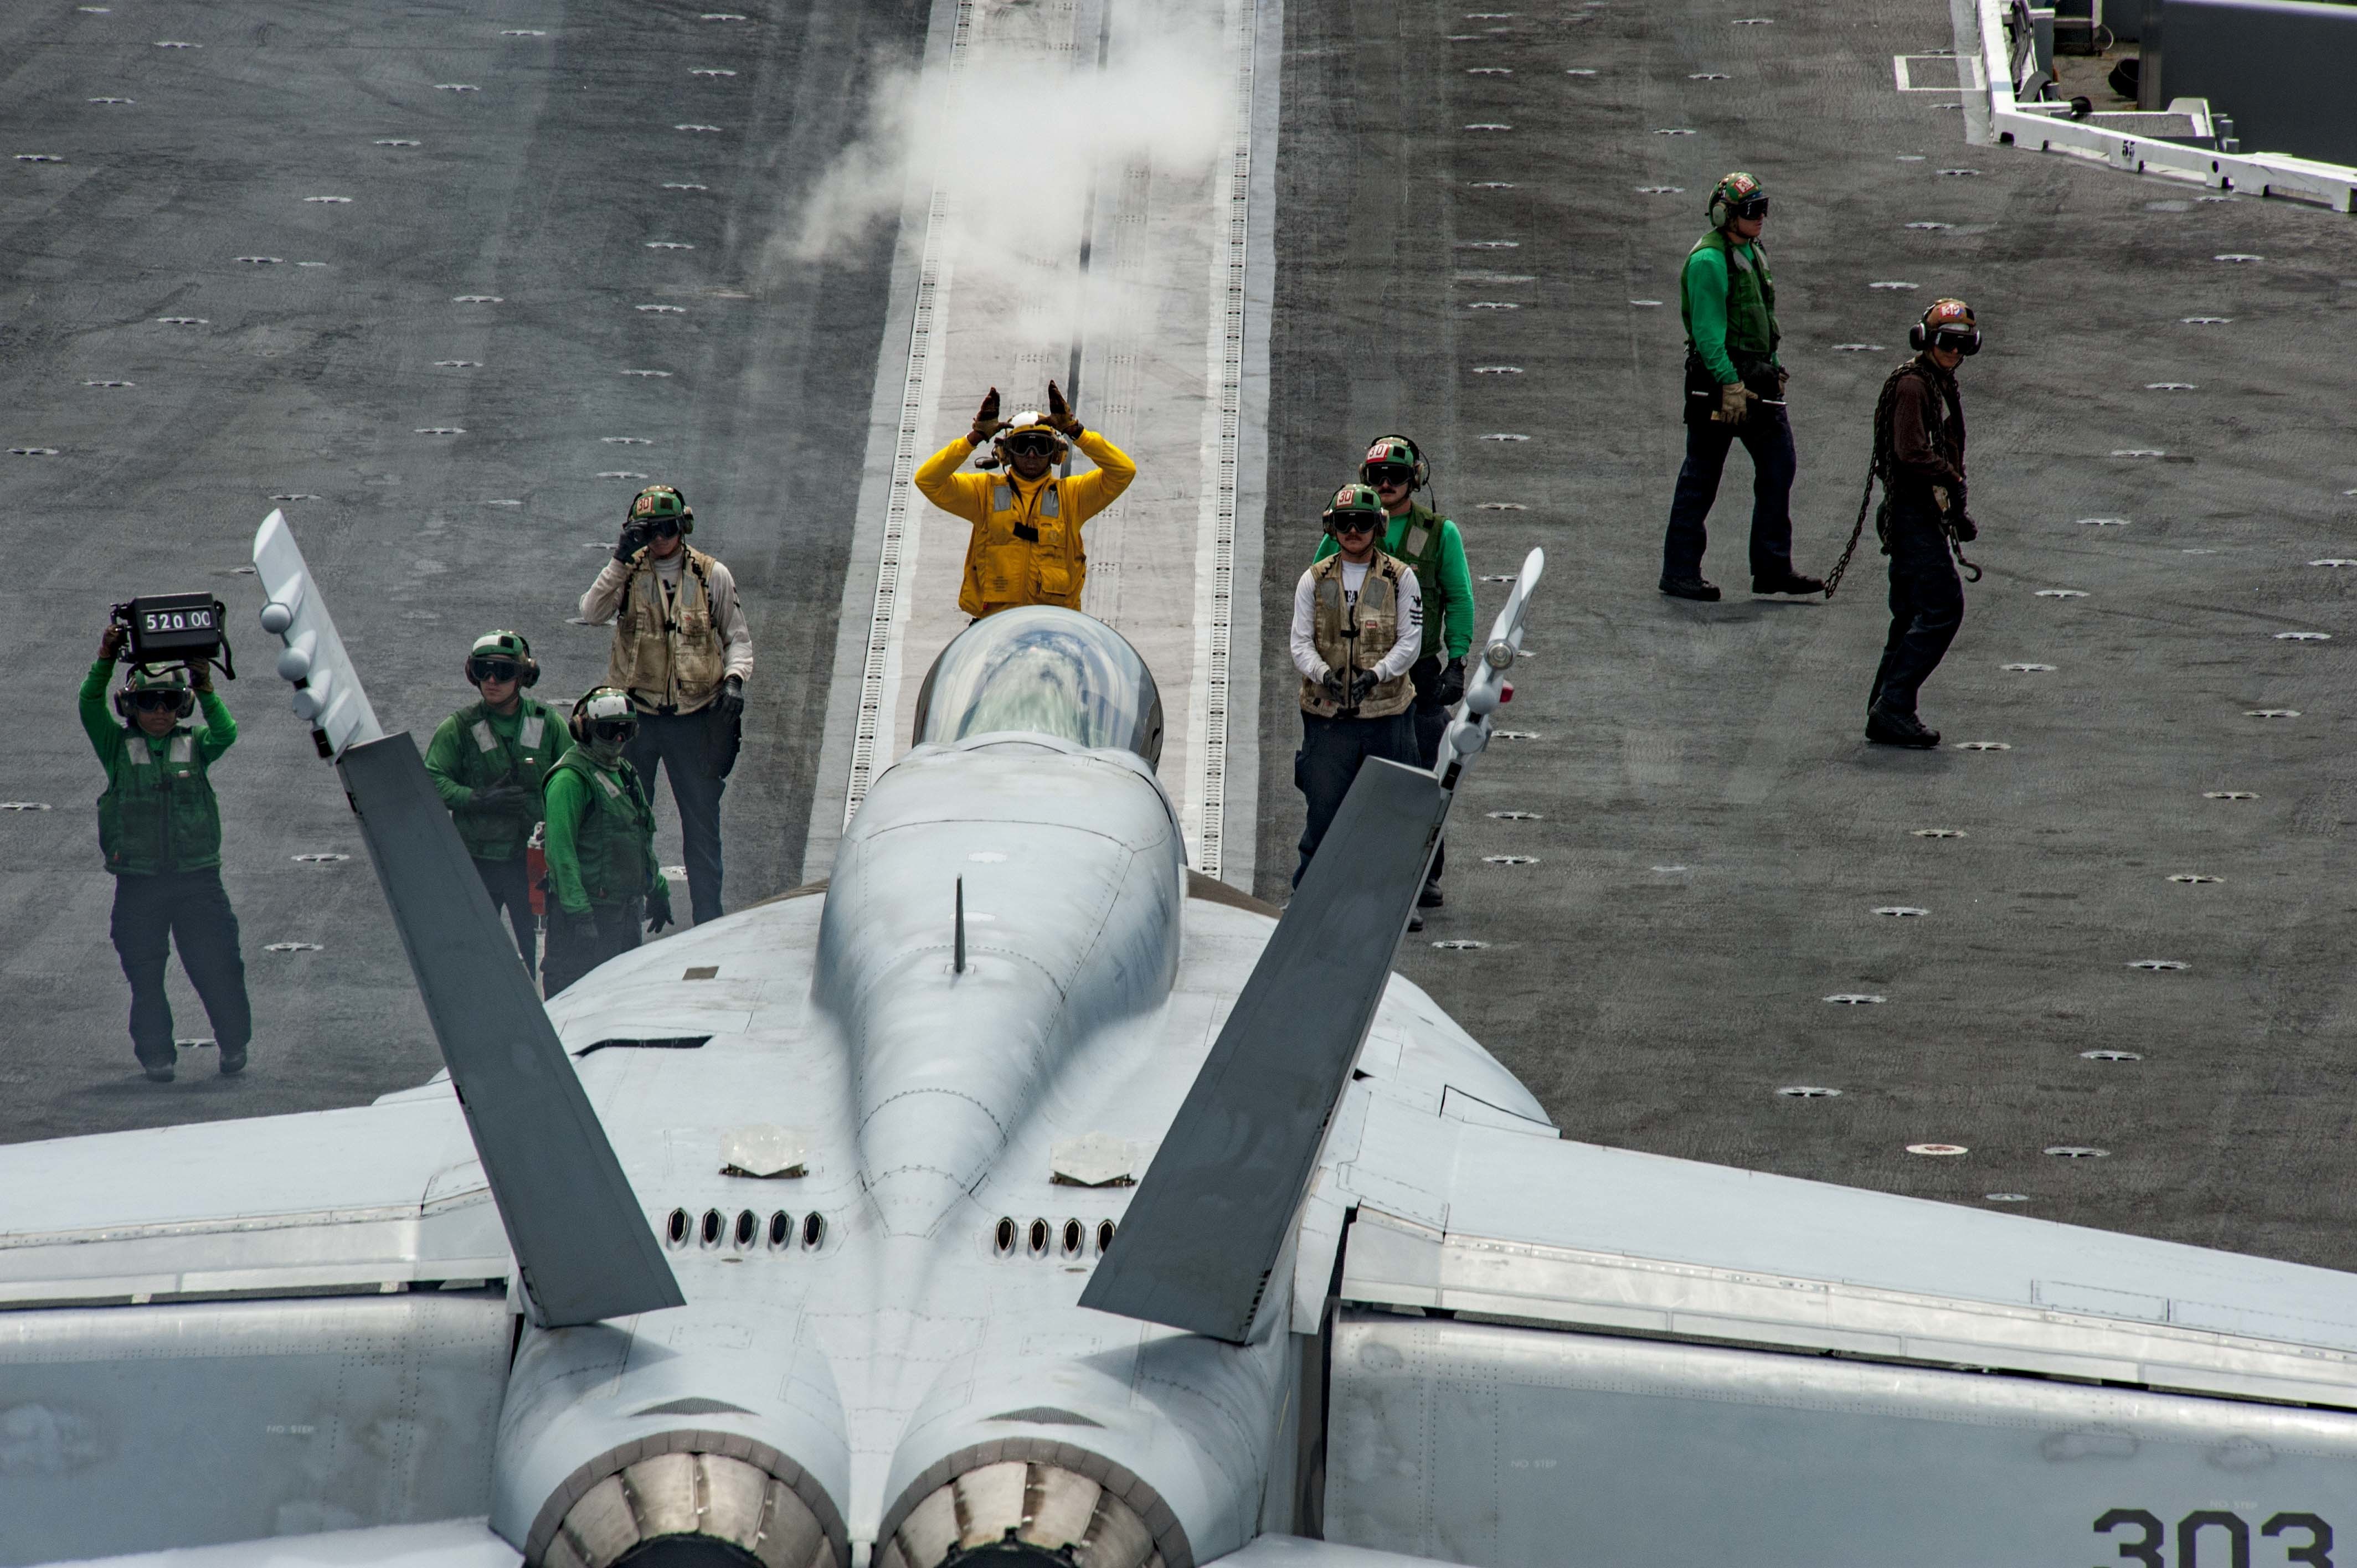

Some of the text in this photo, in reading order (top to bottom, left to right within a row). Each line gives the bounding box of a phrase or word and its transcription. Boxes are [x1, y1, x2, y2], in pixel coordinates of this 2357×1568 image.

[147, 611, 211, 630] 520 00
[266, 1425, 285, 1433] NO
[1511, 1459, 1529, 1468] NO
[2210, 1499, 2229, 1508] NO
[2093, 1508, 2334, 1568] 303
